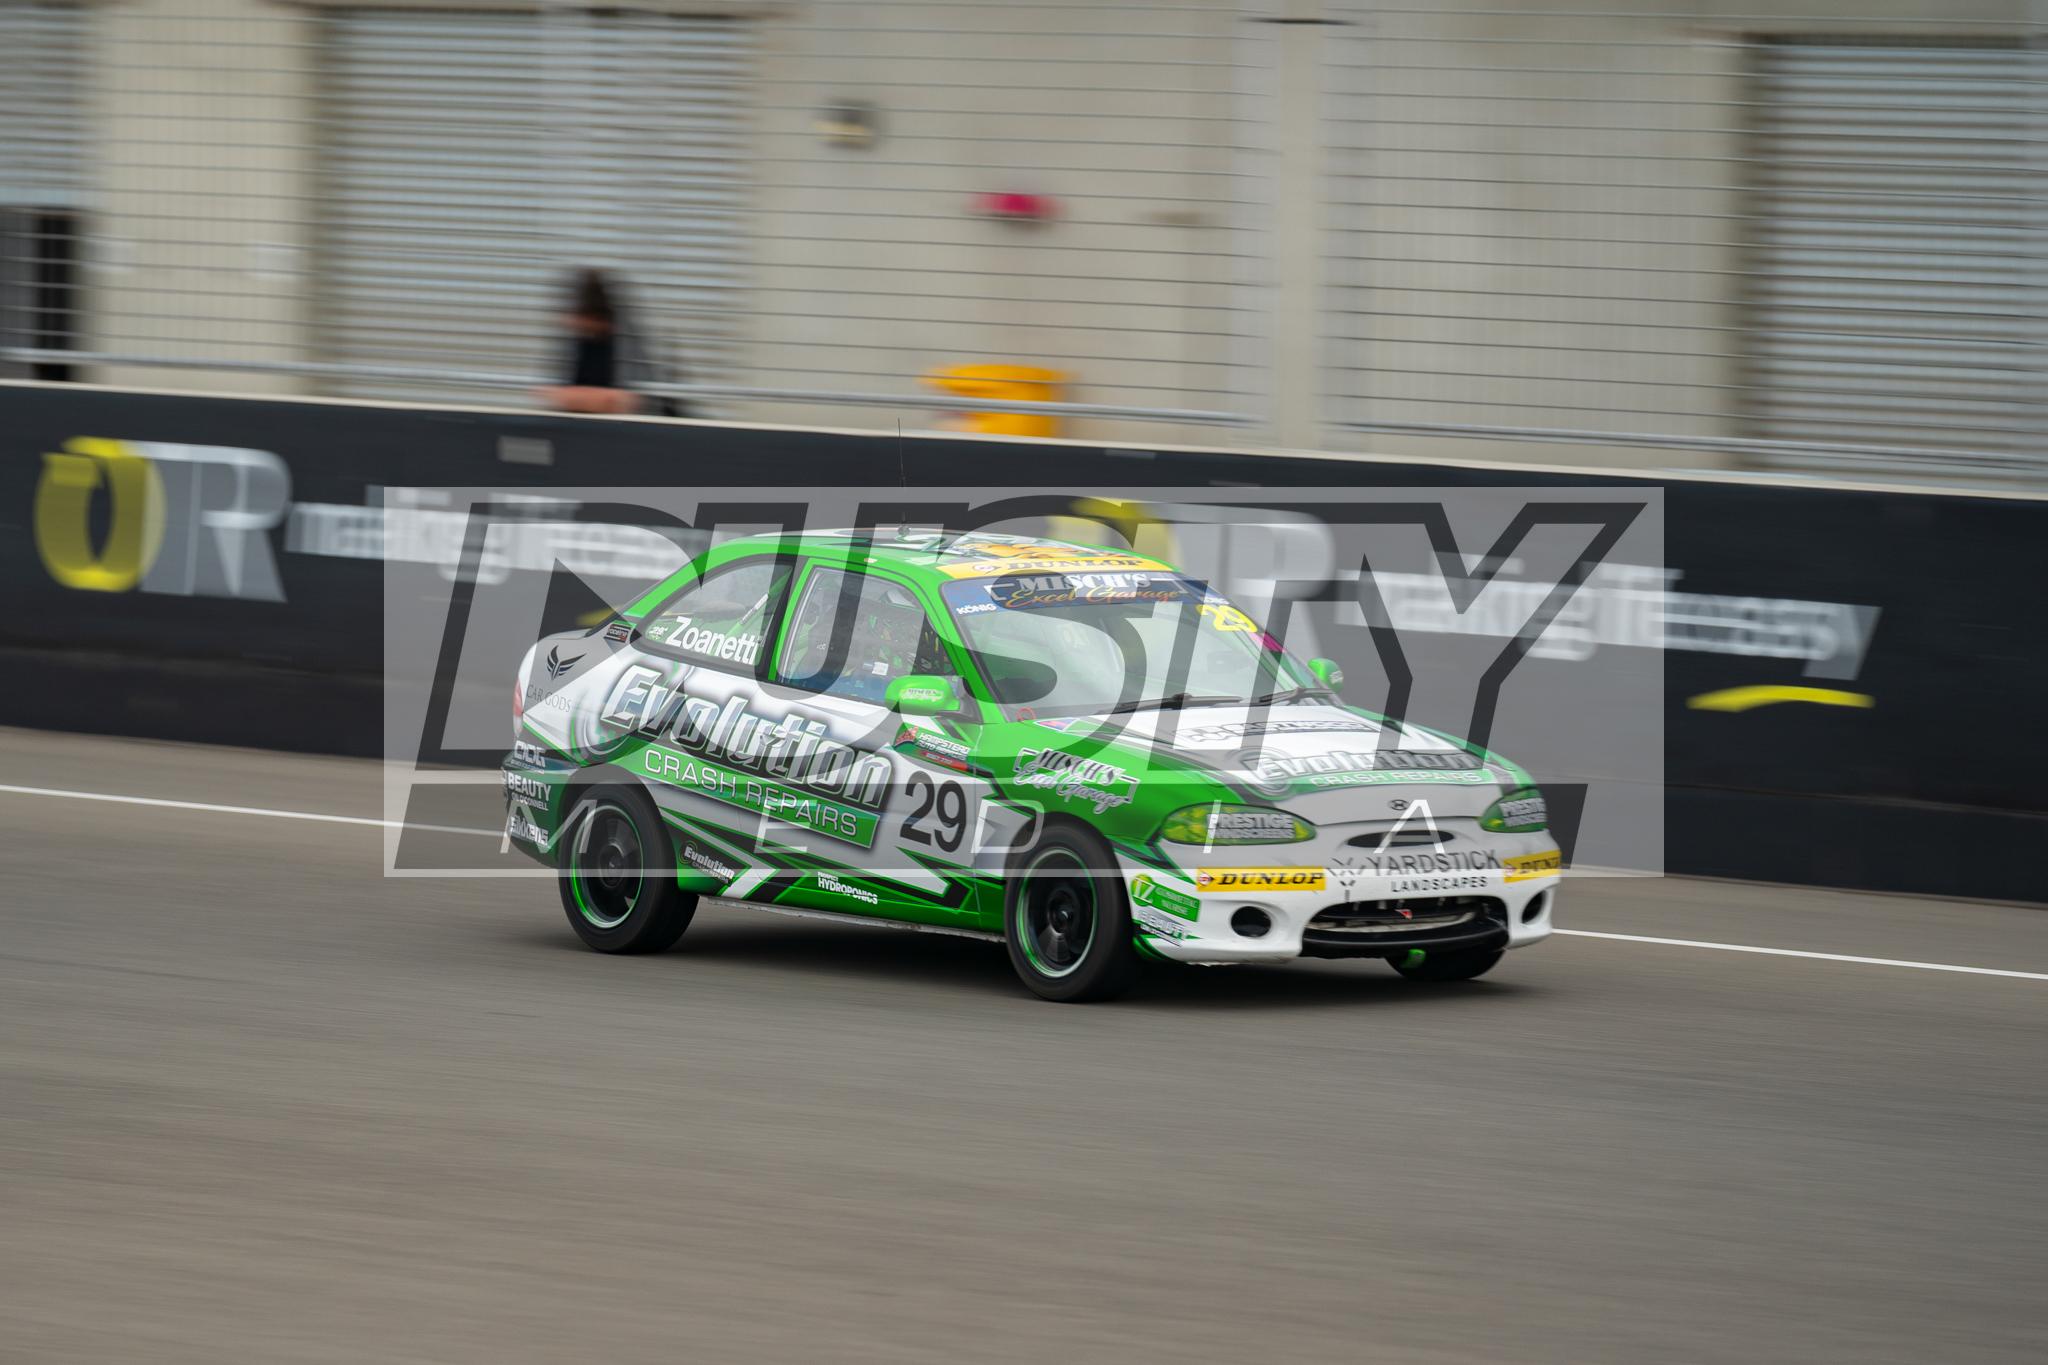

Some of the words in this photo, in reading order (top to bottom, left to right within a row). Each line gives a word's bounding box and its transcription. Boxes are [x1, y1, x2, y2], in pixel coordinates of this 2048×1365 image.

[1007, 557, 1143, 571] DUNLOP
[1004, 585, 1077, 609] Excel
[1015, 572, 1151, 593] MISCH'S
[955, 602, 997, 616] KÖNIG
[1195, 603, 1258, 633] 29
[664, 615, 761, 665] Zoanetti
[526, 683, 544, 702] CAR
[544, 690, 573, 713] GODS
[600, 663, 894, 810] Evolution
[1252, 750, 1484, 780] Evolution
[1309, 771, 1387, 788] CRASH
[1395, 770, 1483, 784] REPAIRS
[507, 771, 552, 802] BEAUTY
[643, 748, 737, 799] CRASH
[745, 782, 858, 837] REPAIRS
[899, 770, 968, 853] 29
[1207, 813, 1295, 830] PRESTIGE
[683, 845, 736, 880] Evolution
[1366, 849, 1501, 877] YARDSTICK
[817, 876, 879, 905] HYDROPONICS
[1217, 872, 1324, 886] DUNLOP
[1390, 876, 1489, 893] LANDSCAPES
